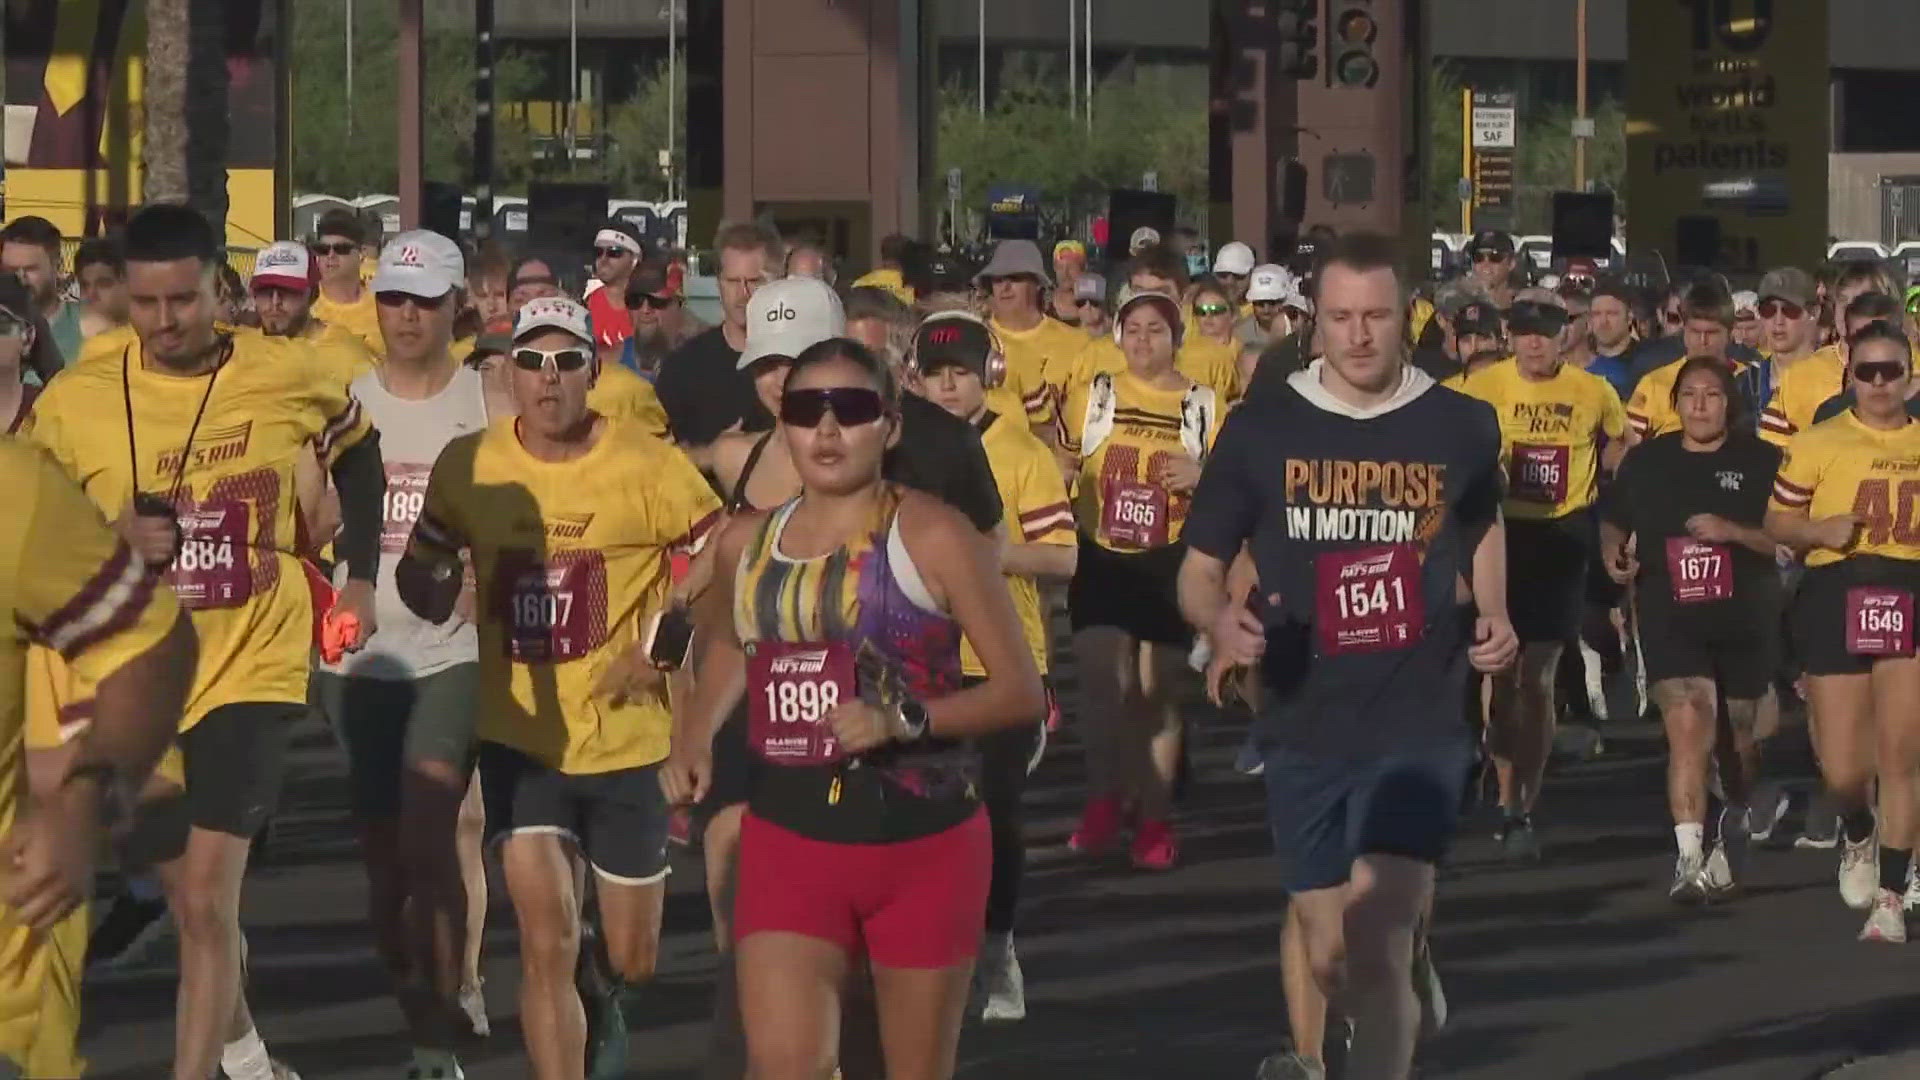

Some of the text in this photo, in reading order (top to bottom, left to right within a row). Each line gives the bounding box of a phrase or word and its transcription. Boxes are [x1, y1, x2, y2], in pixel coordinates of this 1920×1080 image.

[1676, 75, 1775, 109] world
[1483, 131, 1503, 142] SAF
[1654, 139, 1789, 174] patents
[767, 302, 795, 321] alo
[1529, 418, 1570, 433] RUN
[208, 432, 250, 464] RUN
[1285, 459, 1447, 508] PURPOSE
[1115, 500, 1155, 526] 1365
[1286, 507, 1415, 542] IN MOTION
[553, 519, 593, 538] RUN
[1680, 555, 1721, 580] 1677
[511, 591, 573, 627] 1607
[1335, 576, 1405, 619] 1541
[1859, 608, 1904, 632] 1549
[770, 658, 825, 674] PAT'S RUN
[764, 680, 839, 723] 1898
